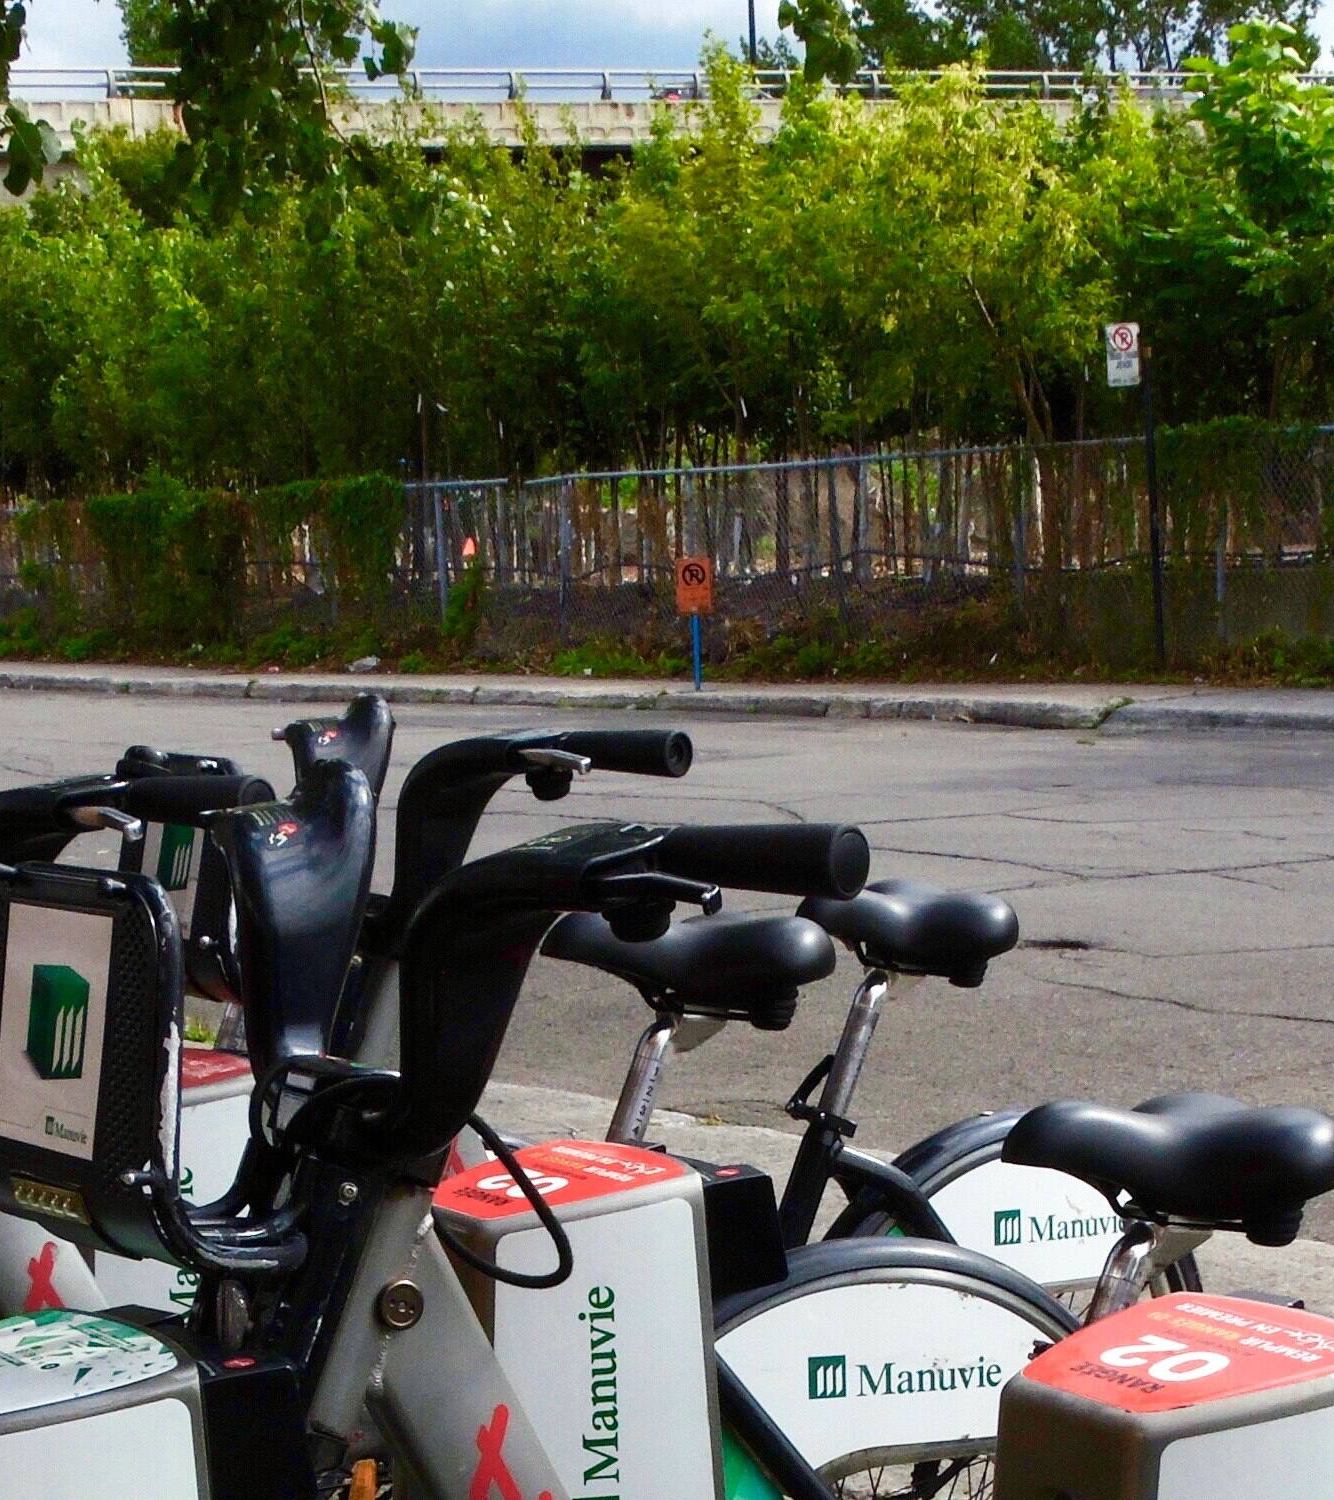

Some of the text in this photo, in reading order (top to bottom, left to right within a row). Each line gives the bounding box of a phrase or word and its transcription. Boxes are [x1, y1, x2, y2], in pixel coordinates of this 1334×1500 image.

[857, 1355, 1003, 1397] Manuvie
[1099, 1334, 1231, 1382] 02
[578, 1286, 620, 1485] Manuvie
